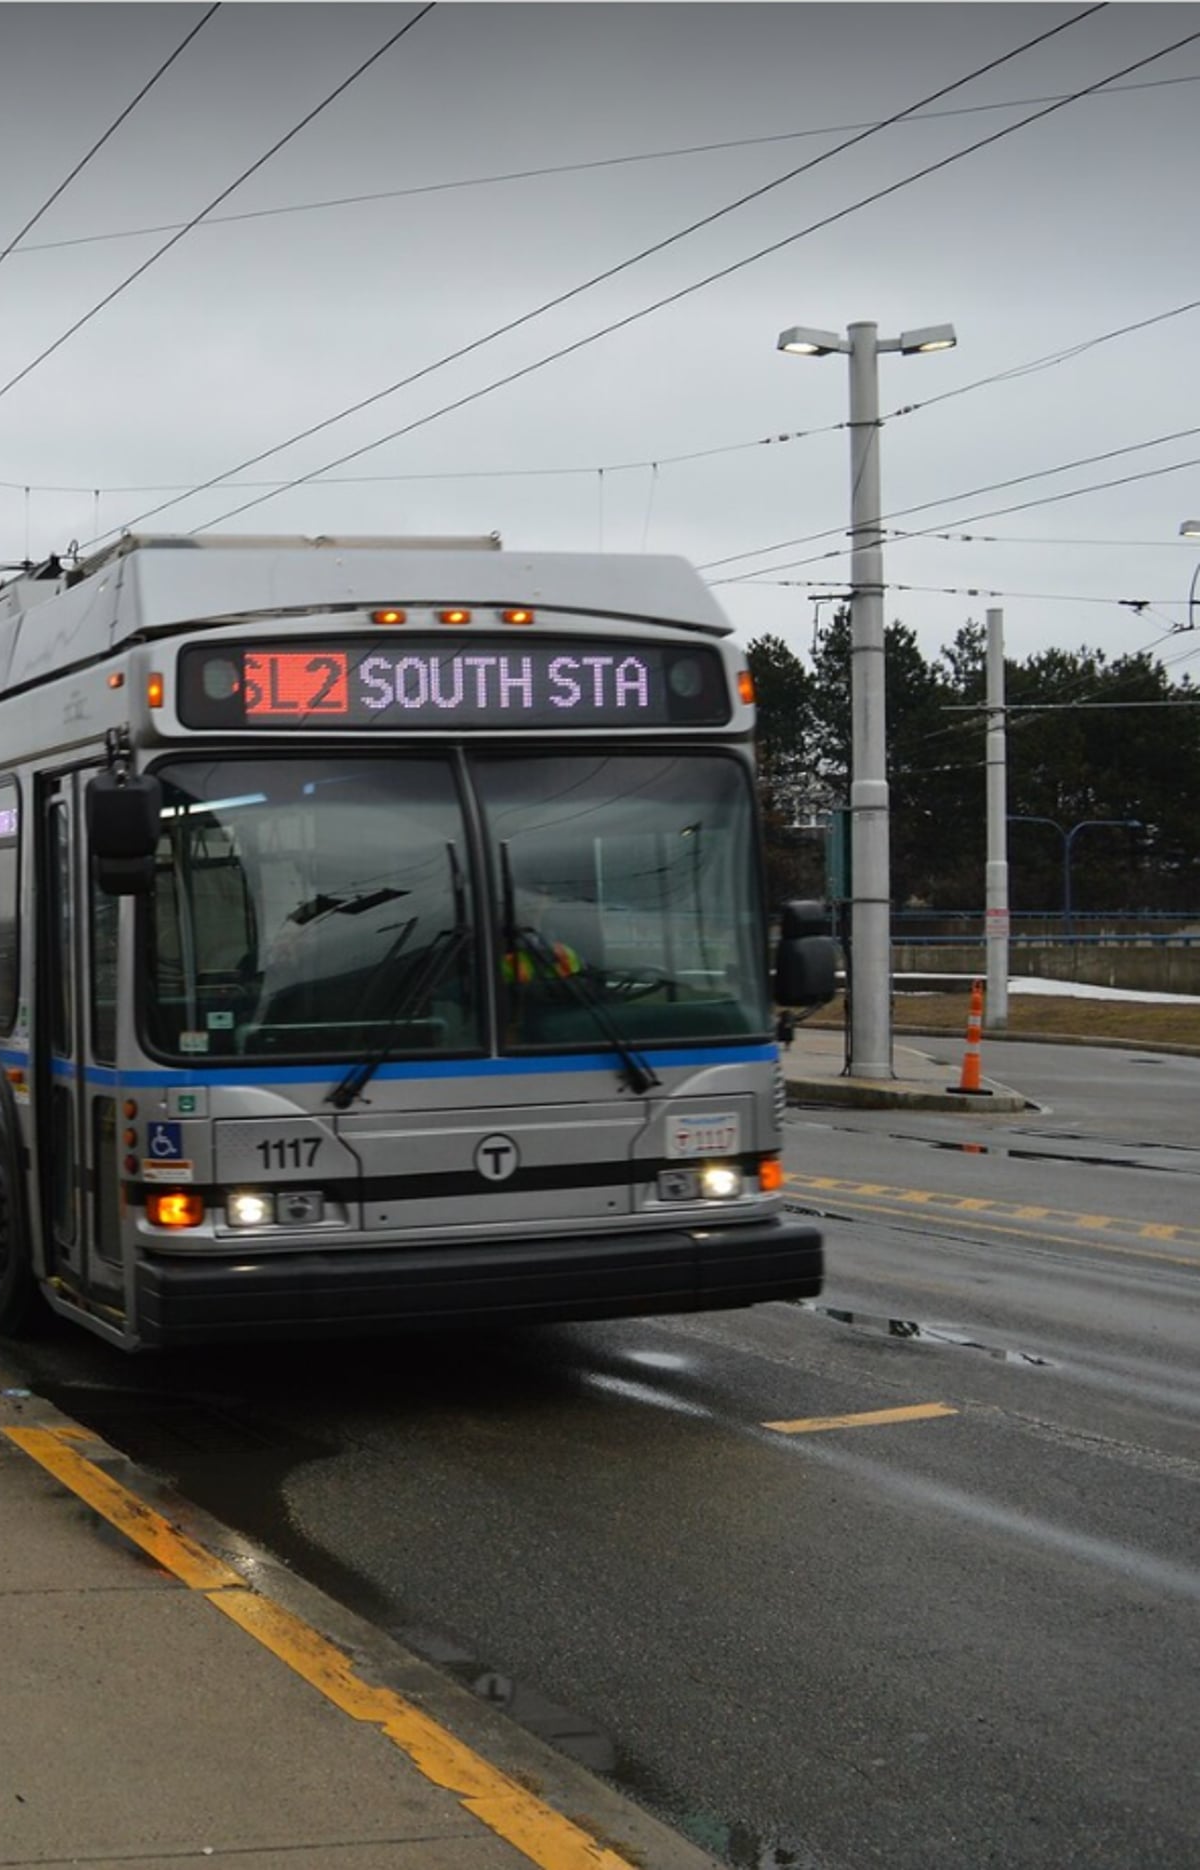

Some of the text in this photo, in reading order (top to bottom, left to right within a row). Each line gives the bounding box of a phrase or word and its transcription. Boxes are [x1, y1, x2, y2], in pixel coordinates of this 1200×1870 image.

[360, 655, 533, 709] SOUTH
[548, 655, 649, 708] STA
[256, 1136, 323, 1170] 1117
